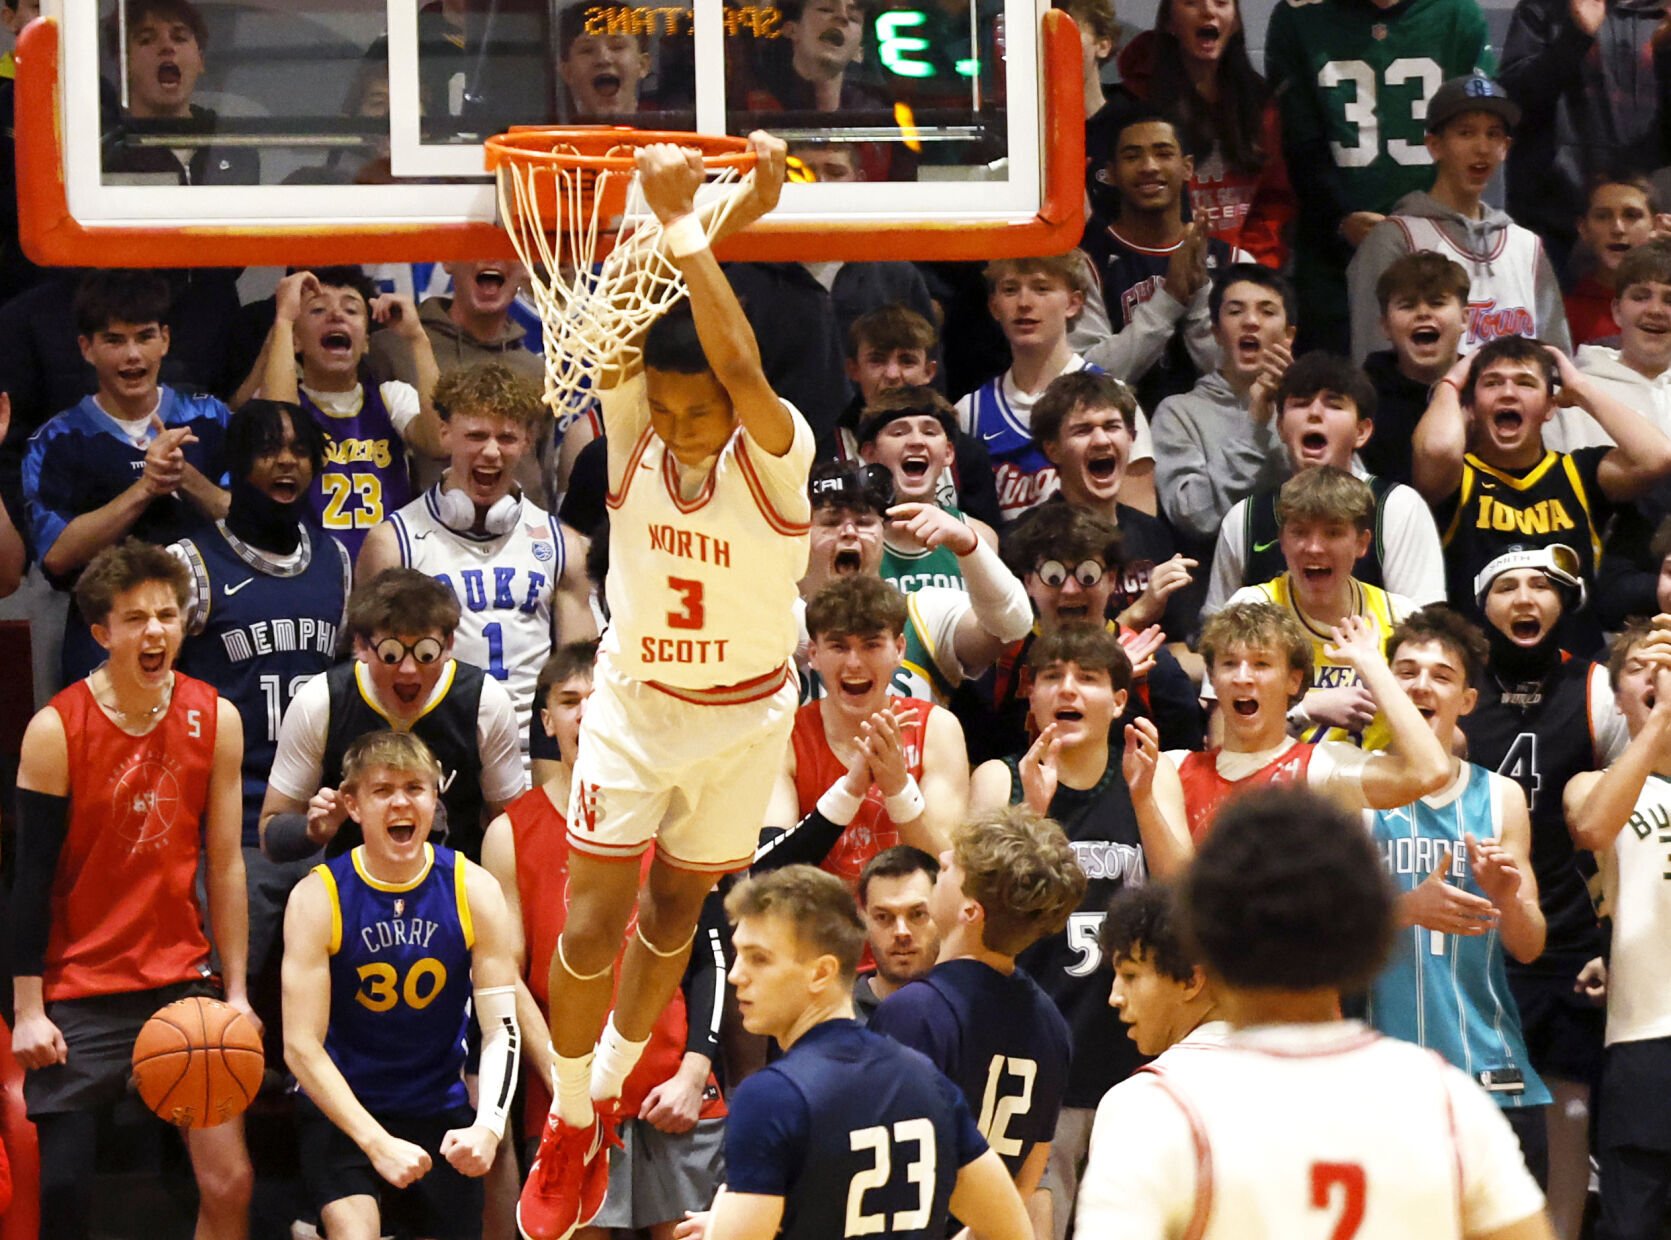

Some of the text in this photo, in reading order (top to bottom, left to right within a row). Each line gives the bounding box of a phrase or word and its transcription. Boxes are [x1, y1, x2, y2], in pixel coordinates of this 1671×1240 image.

[1318, 57, 1442, 167] 33
[322, 473, 384, 529] 23
[1476, 495, 1575, 535] IOWA
[648, 523, 730, 568] NORTH
[667, 575, 704, 630] 3
[482, 622, 509, 680] 1
[641, 636, 729, 664] SCOTT
[187, 710, 201, 738] 5
[1497, 732, 1541, 811] 4
[361, 917, 439, 953] CURRY
[355, 957, 447, 1012] 30
[976, 1053, 1038, 1157] 12
[845, 1117, 936, 1238] 23
